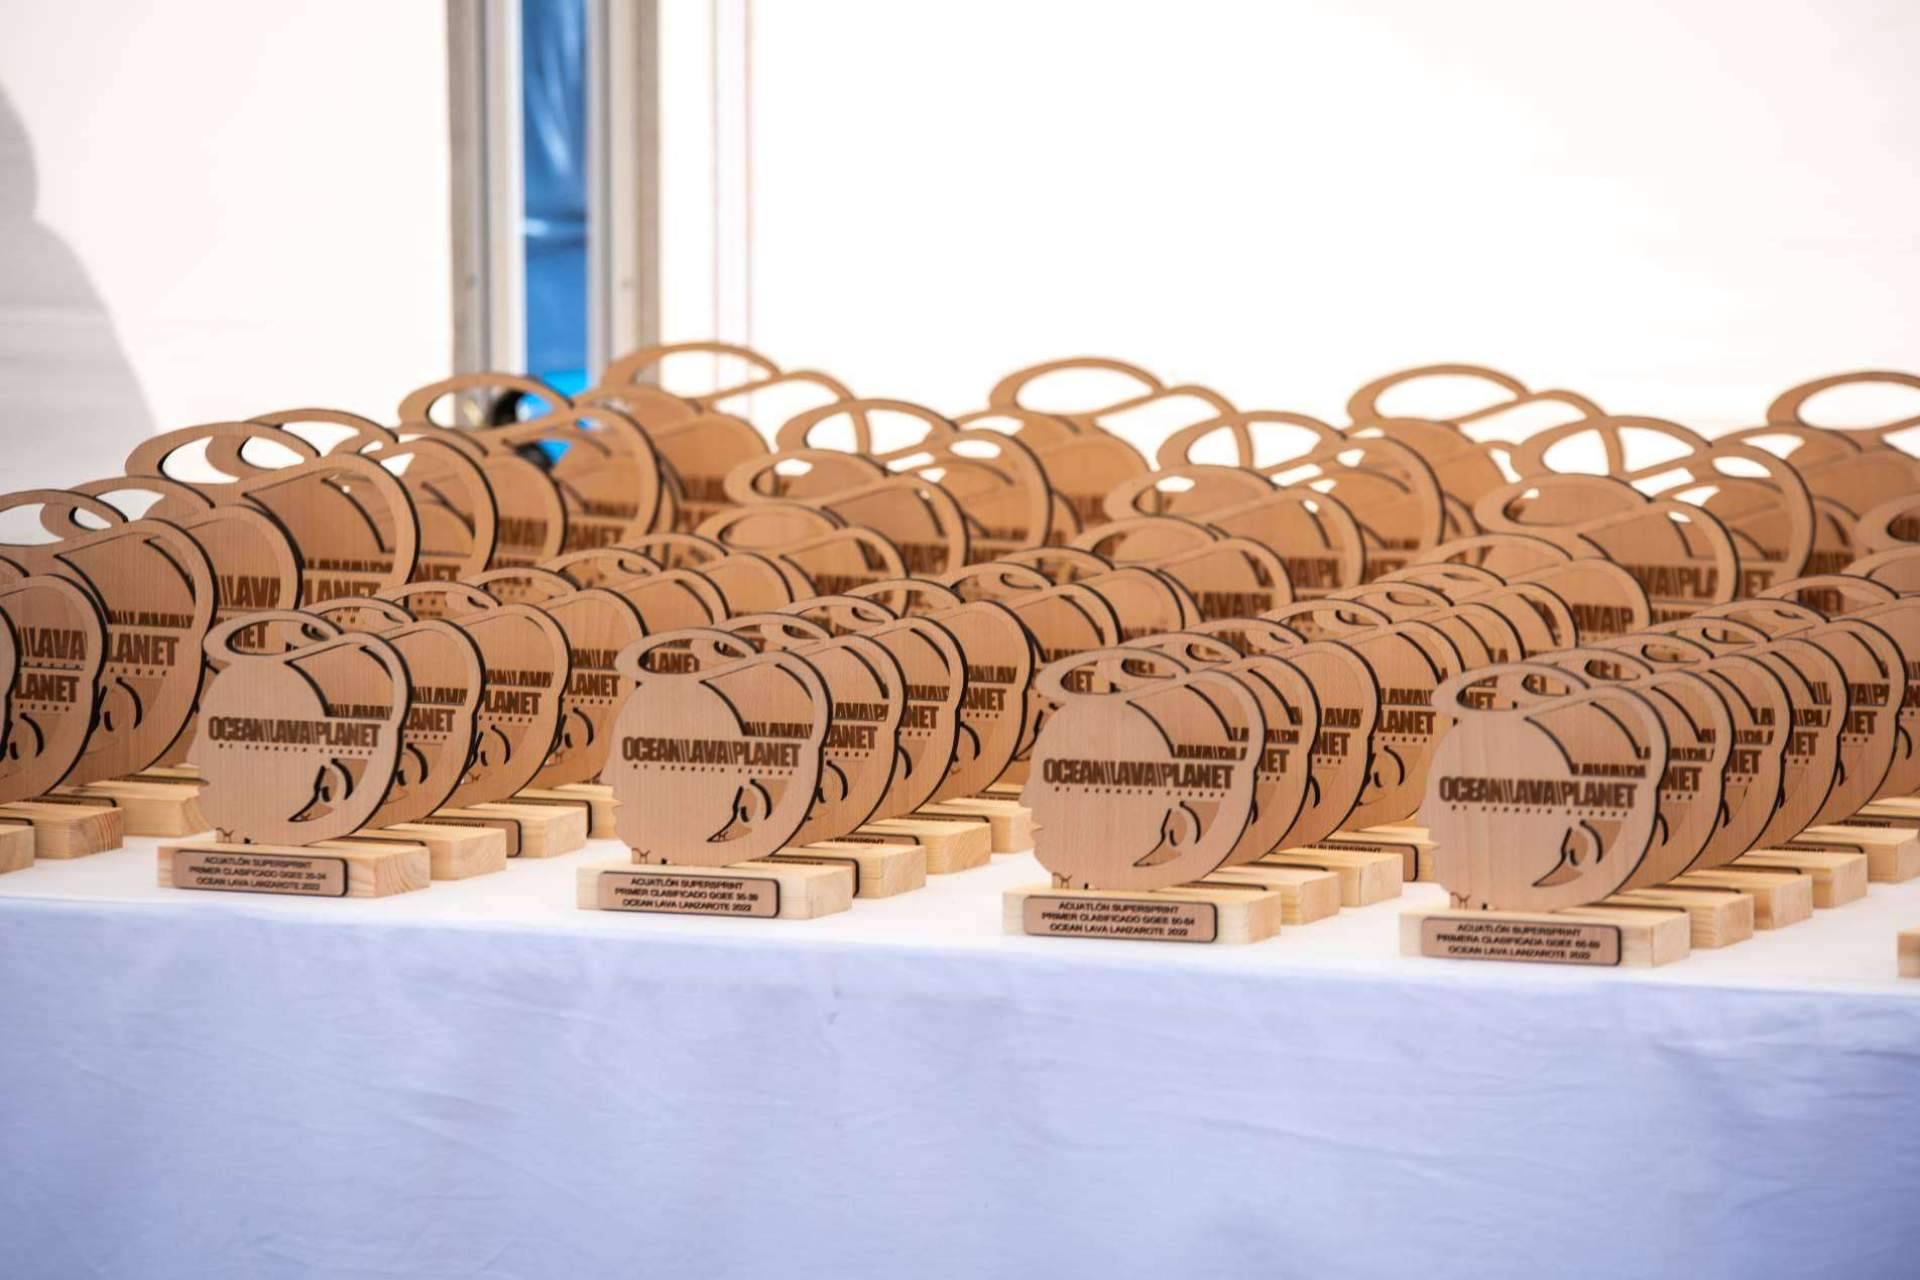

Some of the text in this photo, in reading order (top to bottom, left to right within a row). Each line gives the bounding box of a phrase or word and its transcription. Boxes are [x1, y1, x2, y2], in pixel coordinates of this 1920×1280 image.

[108, 633, 179, 667] LANET
[15, 673, 80, 704] LANET
[196, 876, 226, 886] OCEAN
[227, 878, 249, 887] LAVA
[622, 898, 653, 908] OCEAN
[655, 900, 677, 909] LAVA
[1049, 923, 1083, 932] OCEAN
[1084, 924, 1108, 933] LAVA
[1448, 946, 1484, 955] OCEAN
[1484, 947, 1507, 956] LAVA
